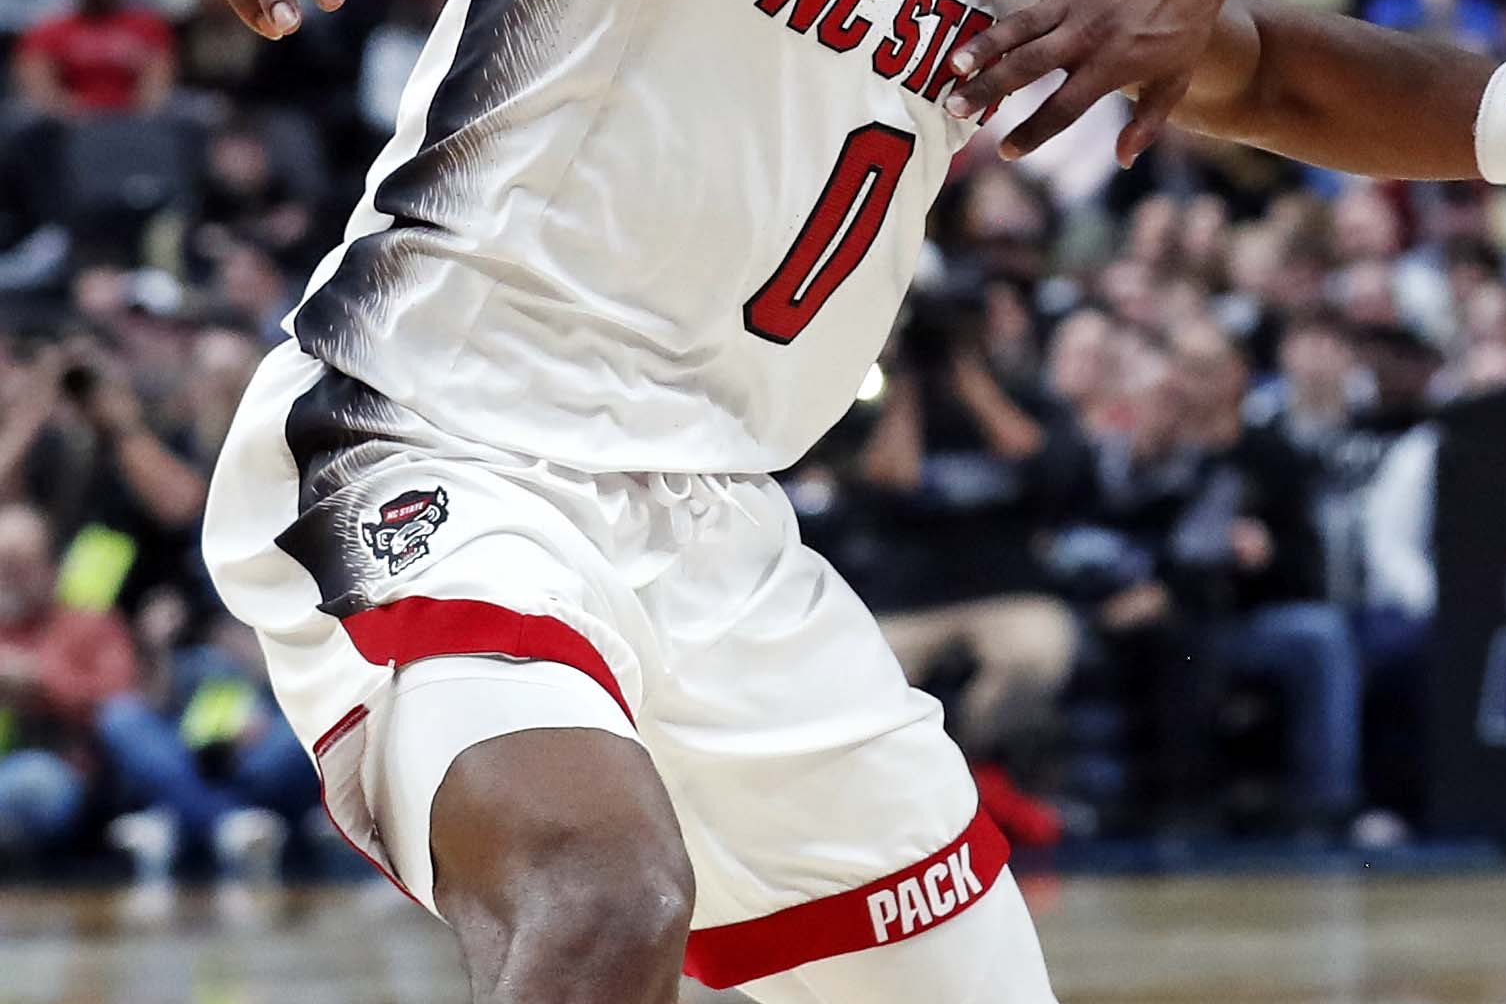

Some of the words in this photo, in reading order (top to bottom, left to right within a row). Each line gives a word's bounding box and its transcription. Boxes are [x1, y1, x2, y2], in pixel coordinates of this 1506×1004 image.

[743, 122, 915, 345] 0
[386, 509, 399, 520] NC
[400, 501, 424, 515] STATE
[866, 842, 983, 943] PACK
